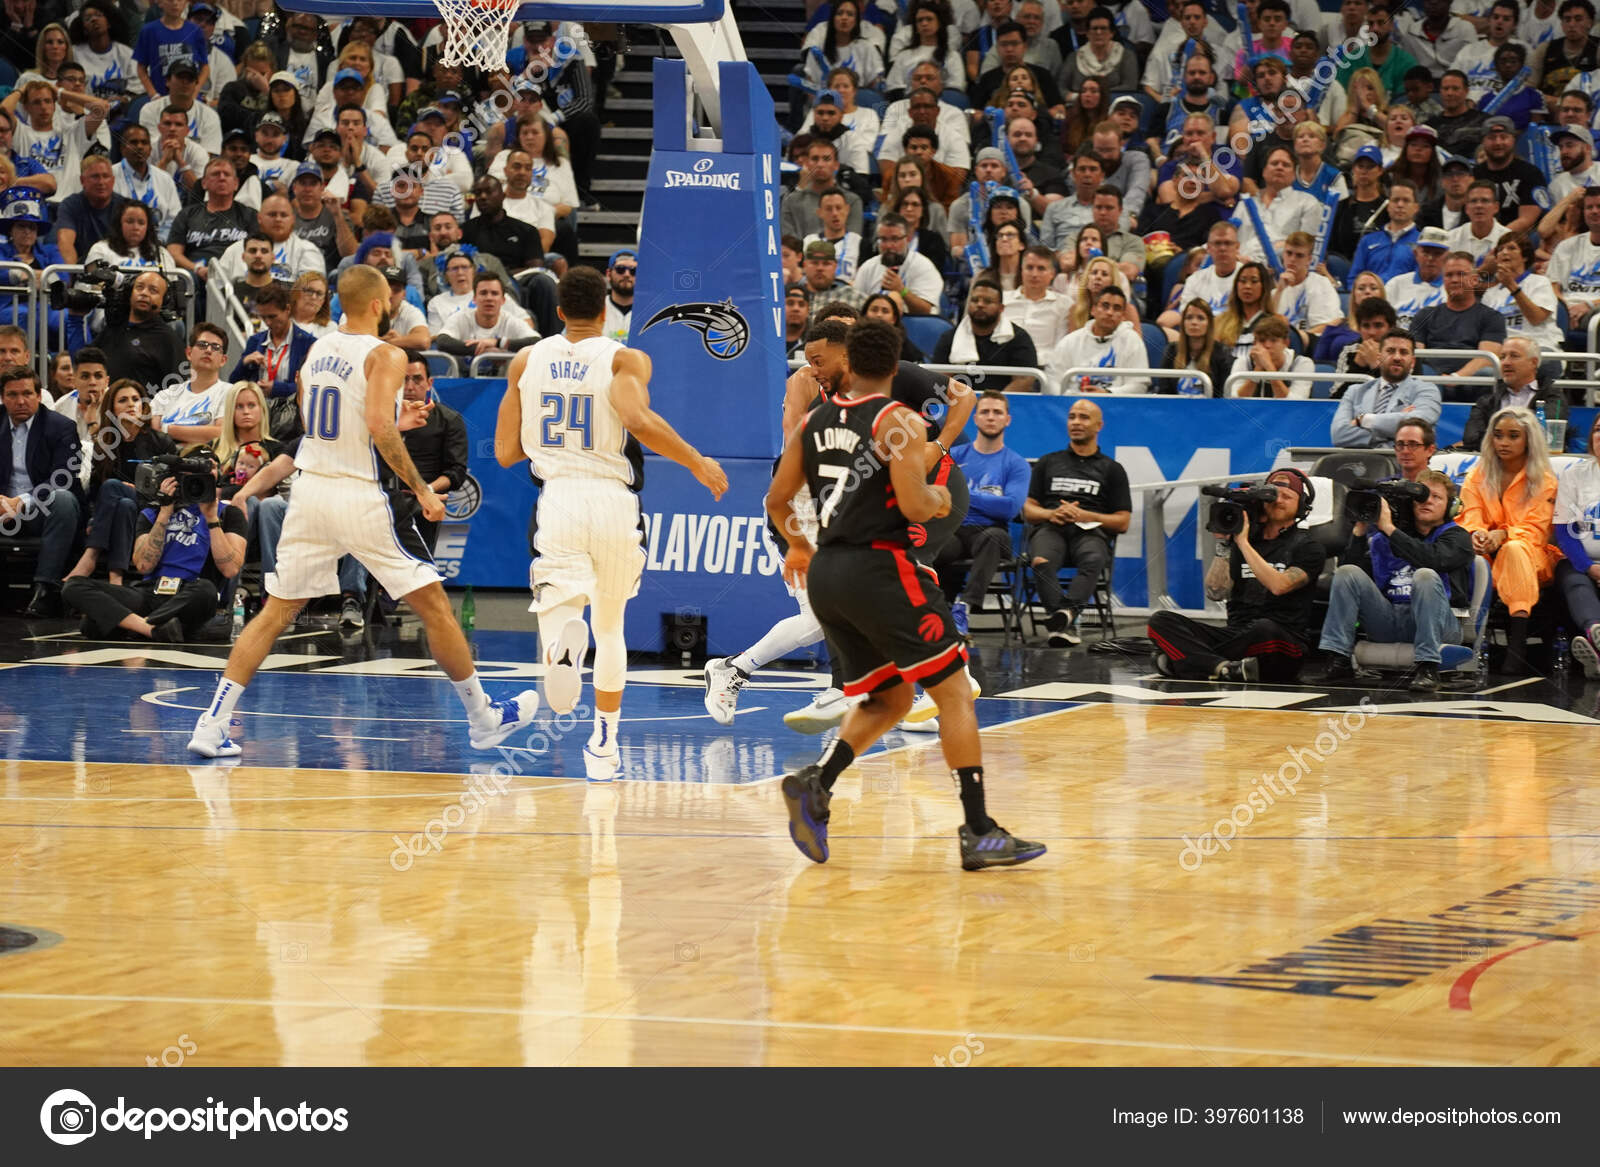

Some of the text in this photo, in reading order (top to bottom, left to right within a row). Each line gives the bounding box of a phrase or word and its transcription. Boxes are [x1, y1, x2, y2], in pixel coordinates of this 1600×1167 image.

[664, 170, 741, 190] SPALDING
[310, 355, 353, 381] FOURNIER
[550, 361, 589, 381] BIRCH
[305, 384, 341, 440] 10
[540, 392, 594, 450] 24
[813, 427, 861, 454] LOWRY
[818, 464, 850, 529] 7
[1051, 477, 1100, 495] ESPN
